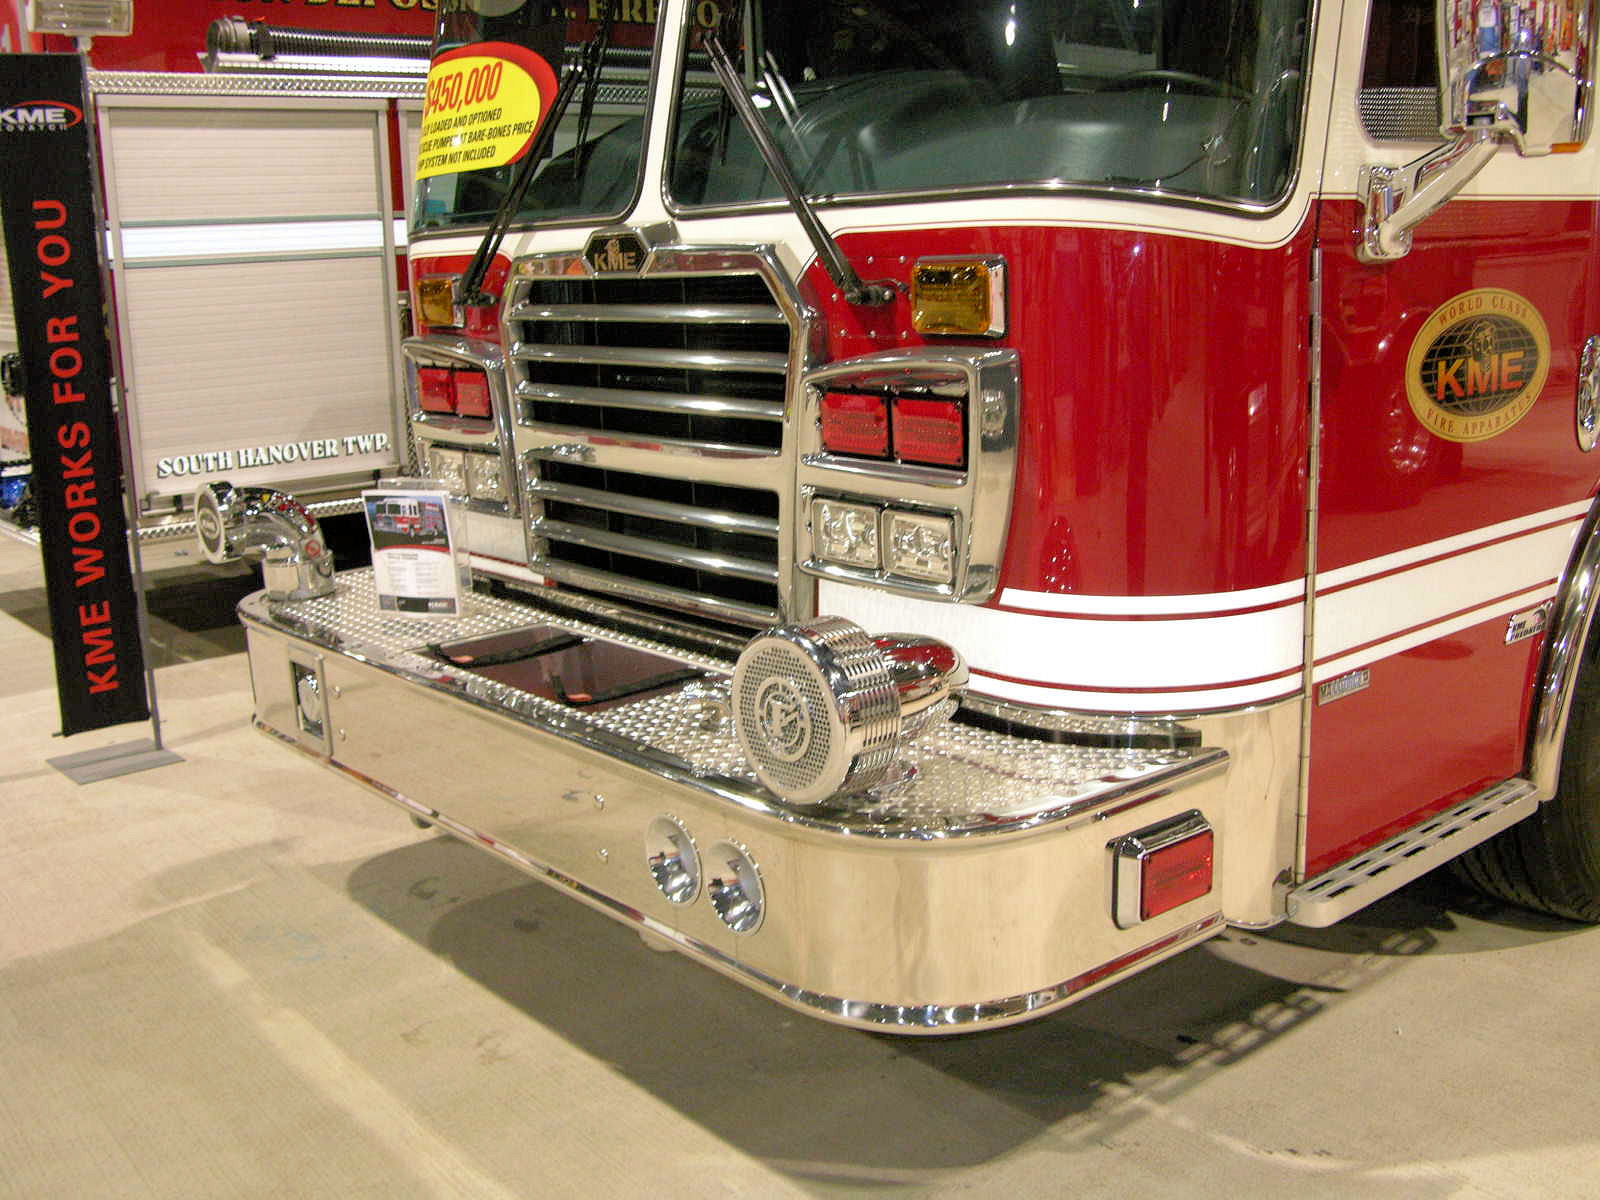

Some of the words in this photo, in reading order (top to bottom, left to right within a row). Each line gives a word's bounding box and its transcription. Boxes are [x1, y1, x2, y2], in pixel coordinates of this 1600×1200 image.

[0, 108, 67, 124] KME
[453, 113, 468, 128] AND
[468, 108, 502, 124] OPTIONED
[468, 125, 511, 142] BARE-BONES
[512, 121, 533, 134] PRICE
[449, 150, 463, 164] NOT
[463, 145, 496, 161] INCLUDED
[32, 199, 74, 299] YOU
[593, 252, 637, 271] KME
[1438, 296, 1482, 325] WORLD
[47, 315, 87, 404] FOR
[1436, 351, 1526, 400] KME
[157, 453, 232, 478] SOUTH
[238, 438, 339, 468] HANOVER
[57, 420, 106, 588] WORKS
[80, 600, 119, 694] KME
